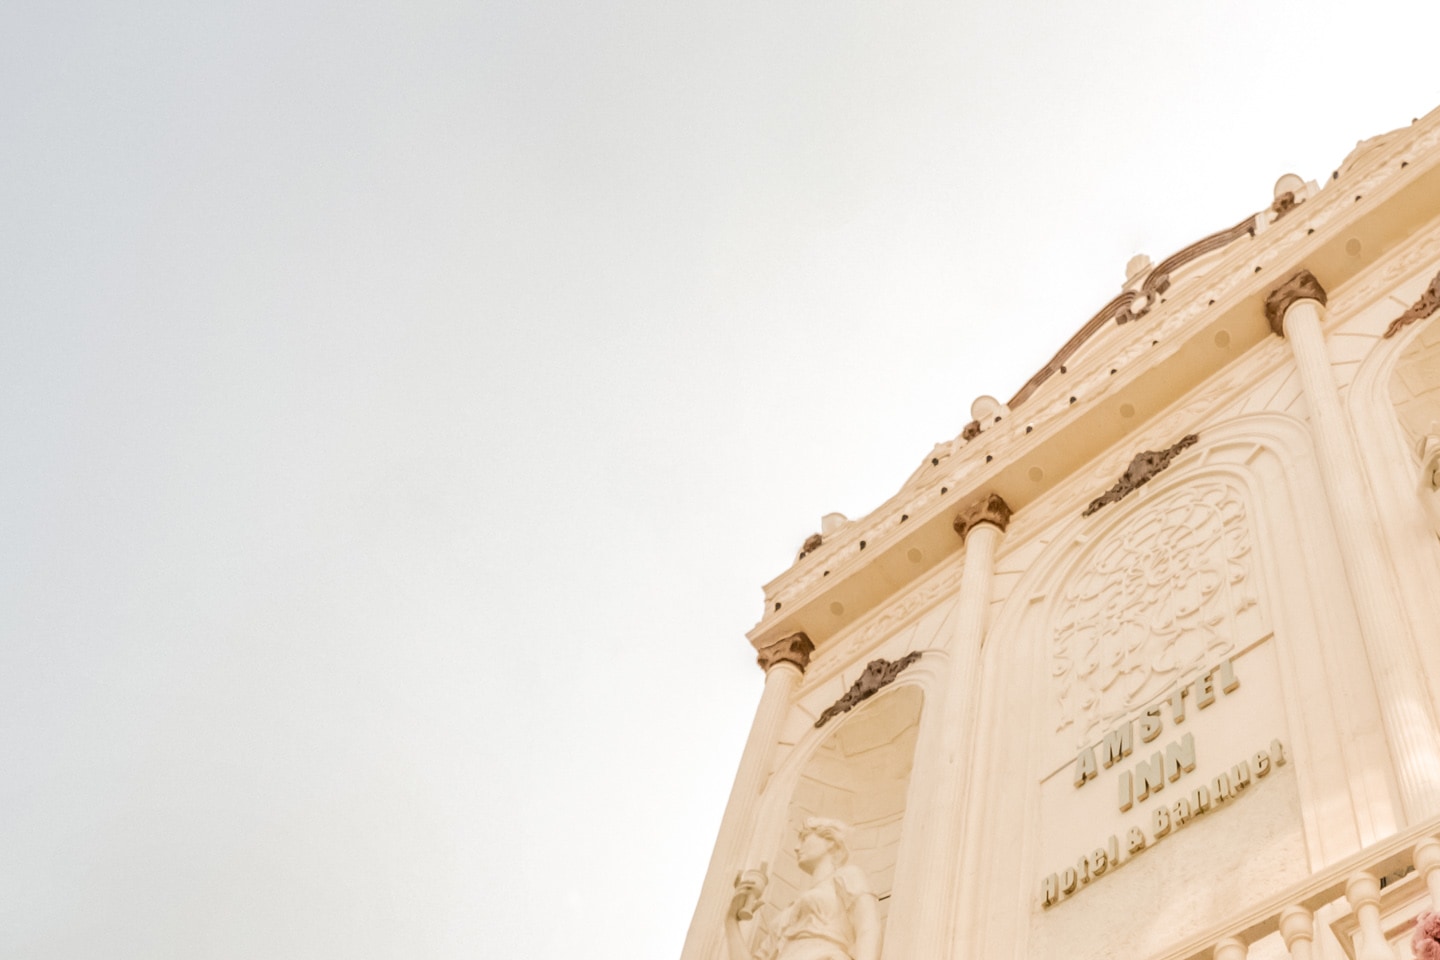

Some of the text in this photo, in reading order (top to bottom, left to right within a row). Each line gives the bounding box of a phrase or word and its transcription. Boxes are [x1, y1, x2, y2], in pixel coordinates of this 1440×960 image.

[1073, 657, 1241, 789] AMSTEL
[1118, 731, 1196, 814] INN
[1040, 738, 1287, 910] Hotel & Banquet
